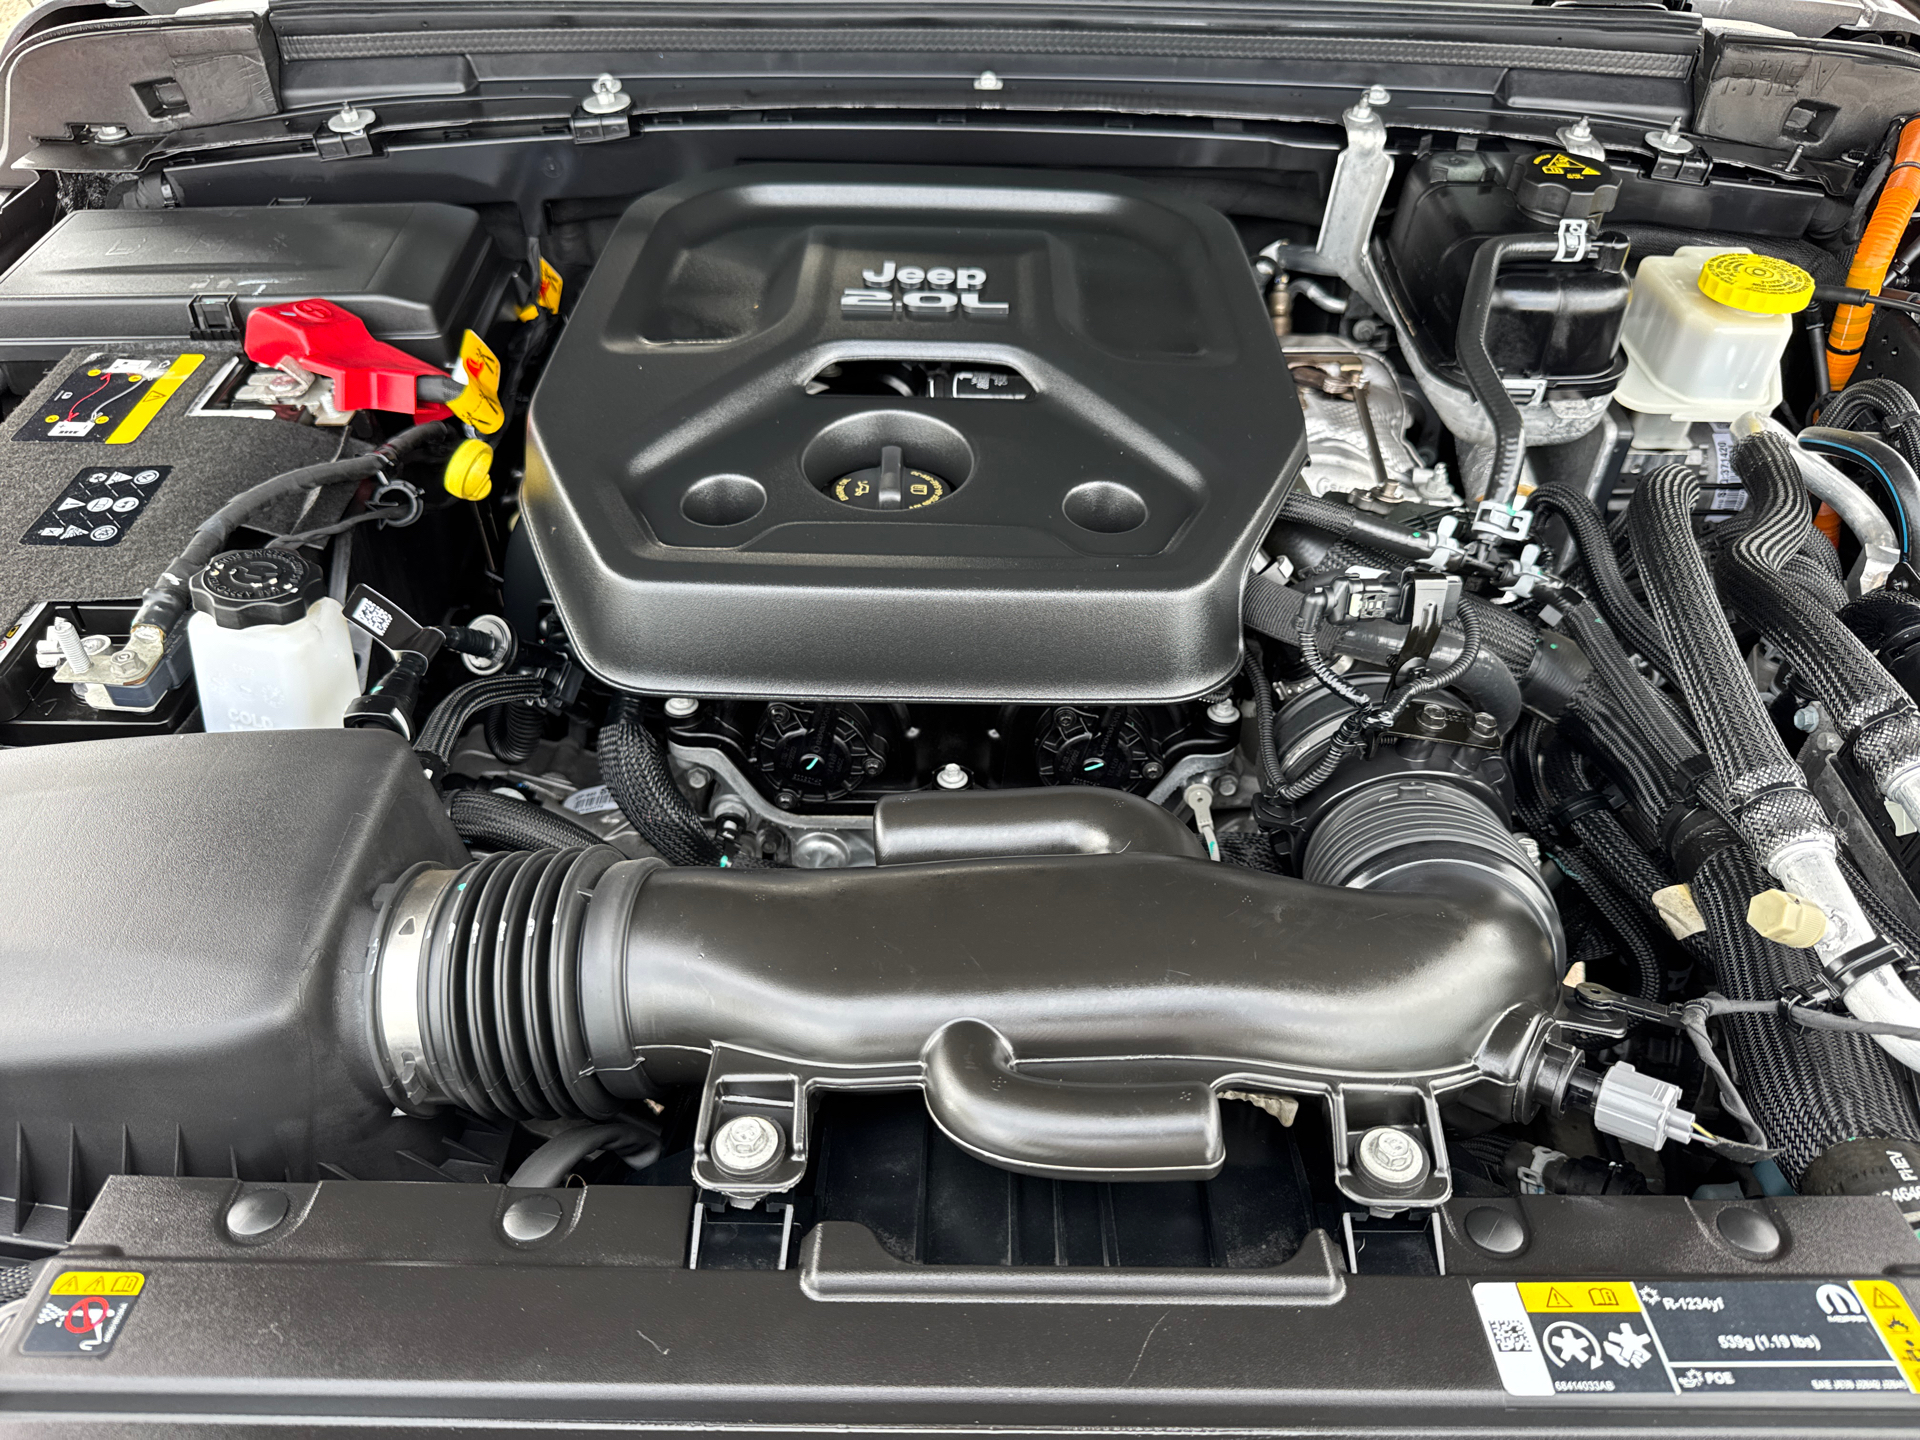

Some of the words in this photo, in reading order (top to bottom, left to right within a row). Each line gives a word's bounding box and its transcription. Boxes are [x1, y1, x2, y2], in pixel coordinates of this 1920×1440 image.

[1720, 58, 1843, 97] PHEV
[862, 260, 987, 290] Jeep
[840, 287, 1010, 315] 2.0L
[228, 707, 274, 729] COLD
[1662, 1296, 1725, 1313] R-1234yf
[1717, 1334, 1755, 1352] 539g
[1754, 1333, 1791, 1352] (1.19
[1790, 1333, 1821, 1352] lbs)
[1554, 1380, 1616, 1392] 68414033AB
[1704, 1371, 1735, 1385] POE
